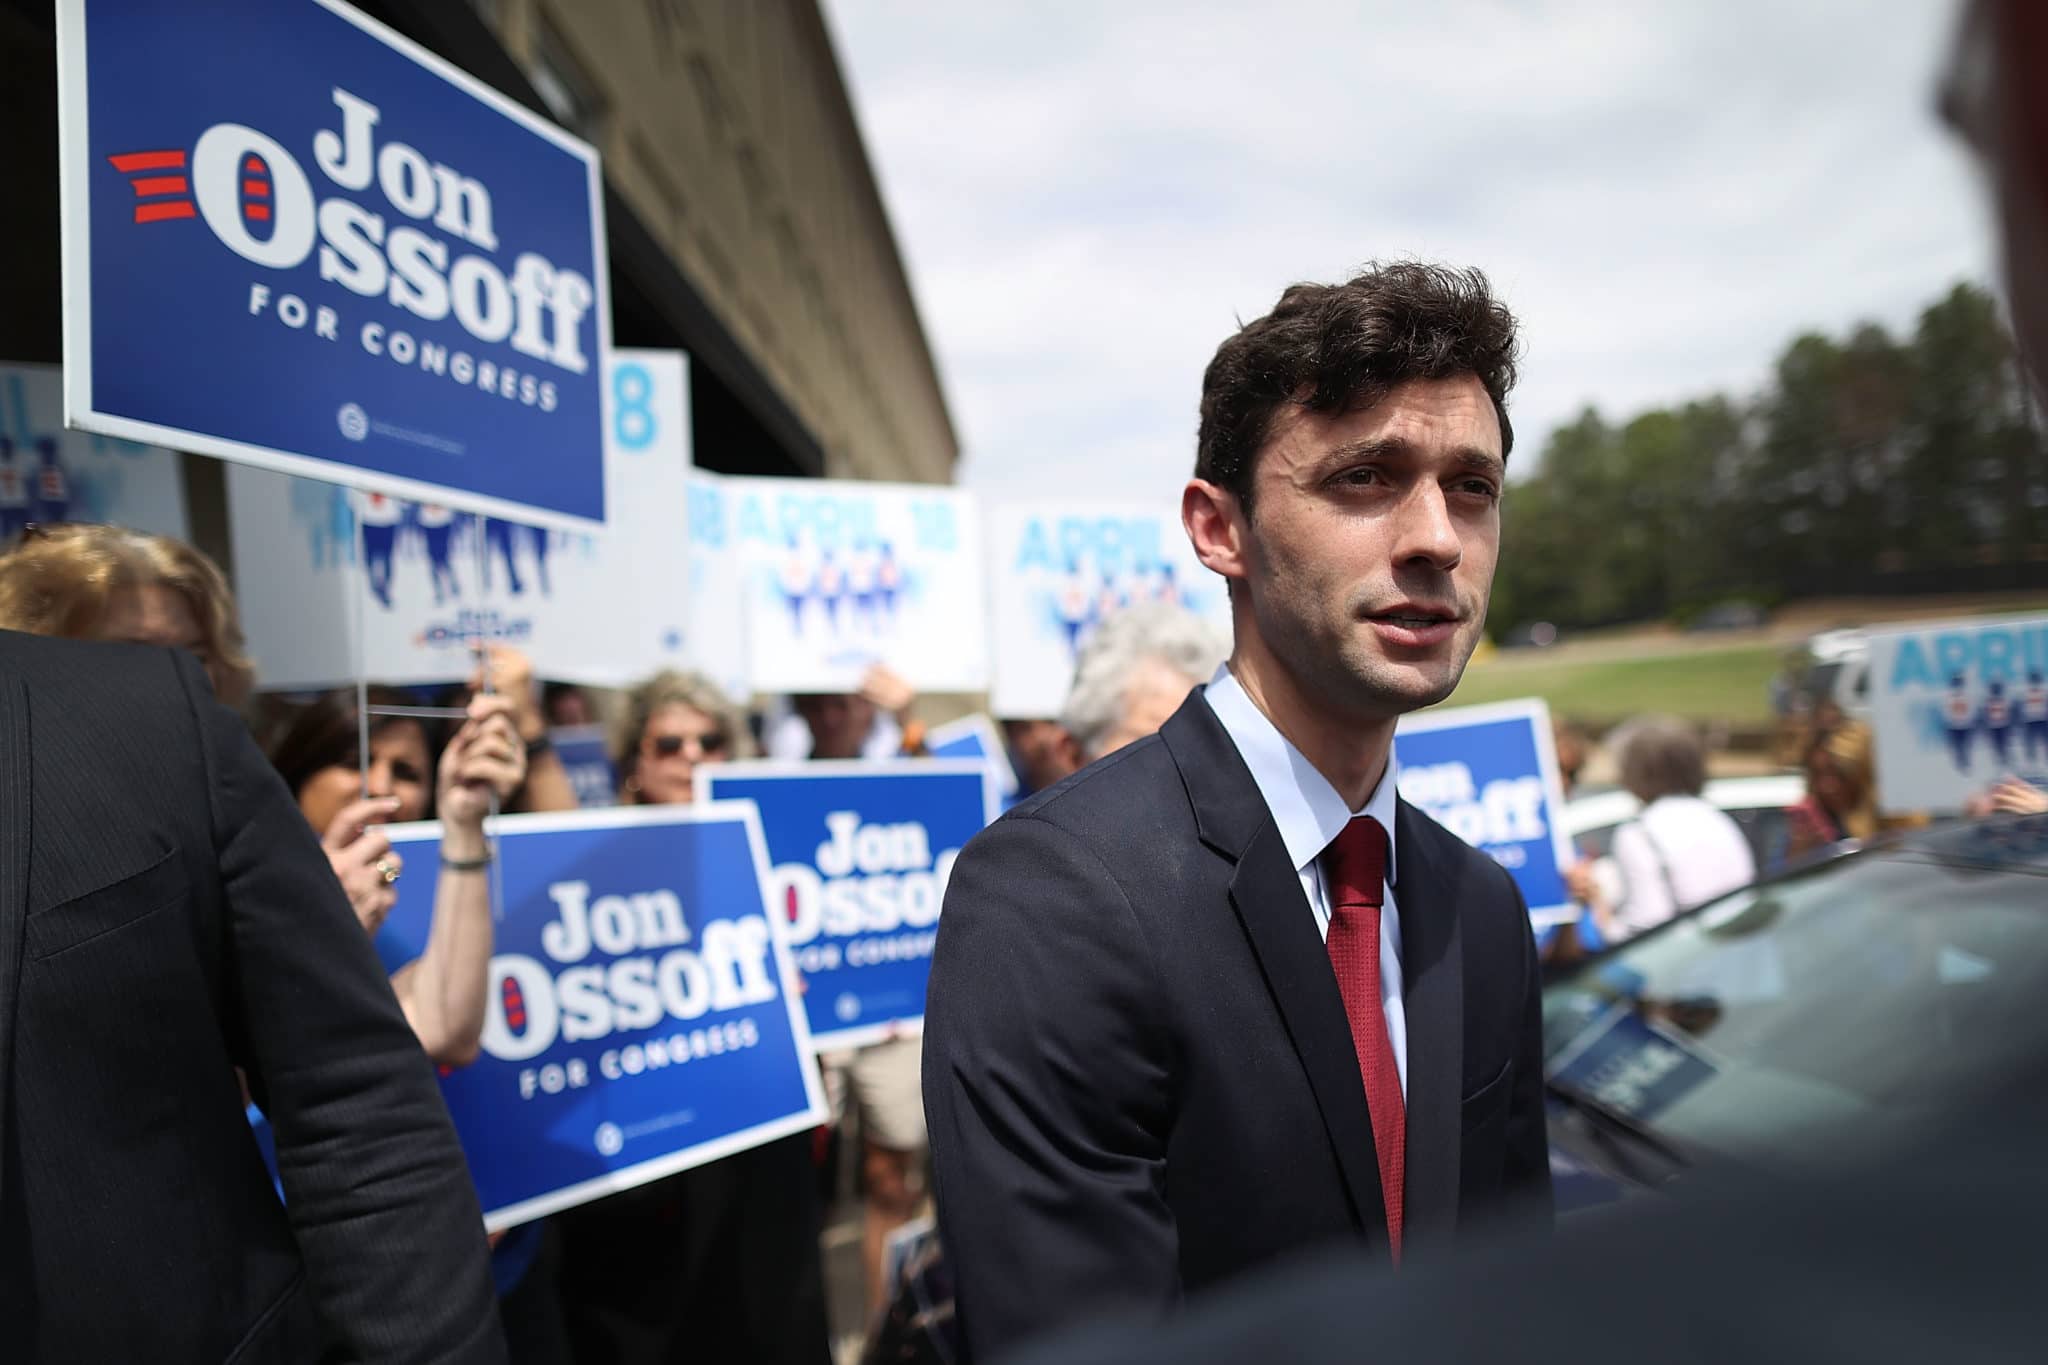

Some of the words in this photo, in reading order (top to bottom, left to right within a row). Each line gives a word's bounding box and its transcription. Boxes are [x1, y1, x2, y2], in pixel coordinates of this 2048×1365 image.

[313, 87, 496, 250] Jon
[193, 123, 593, 373] Ossoff
[249, 284, 340, 341] FOR
[361, 322, 558, 412] CONGRESS
[772, 850, 957, 945] Osso
[815, 811, 931, 876] Jon
[542, 881, 689, 963] Jon
[479, 914, 776, 1061] Ossoff
[520, 1065, 587, 1099] FOR
[601, 1019, 757, 1079] CONGRESS
